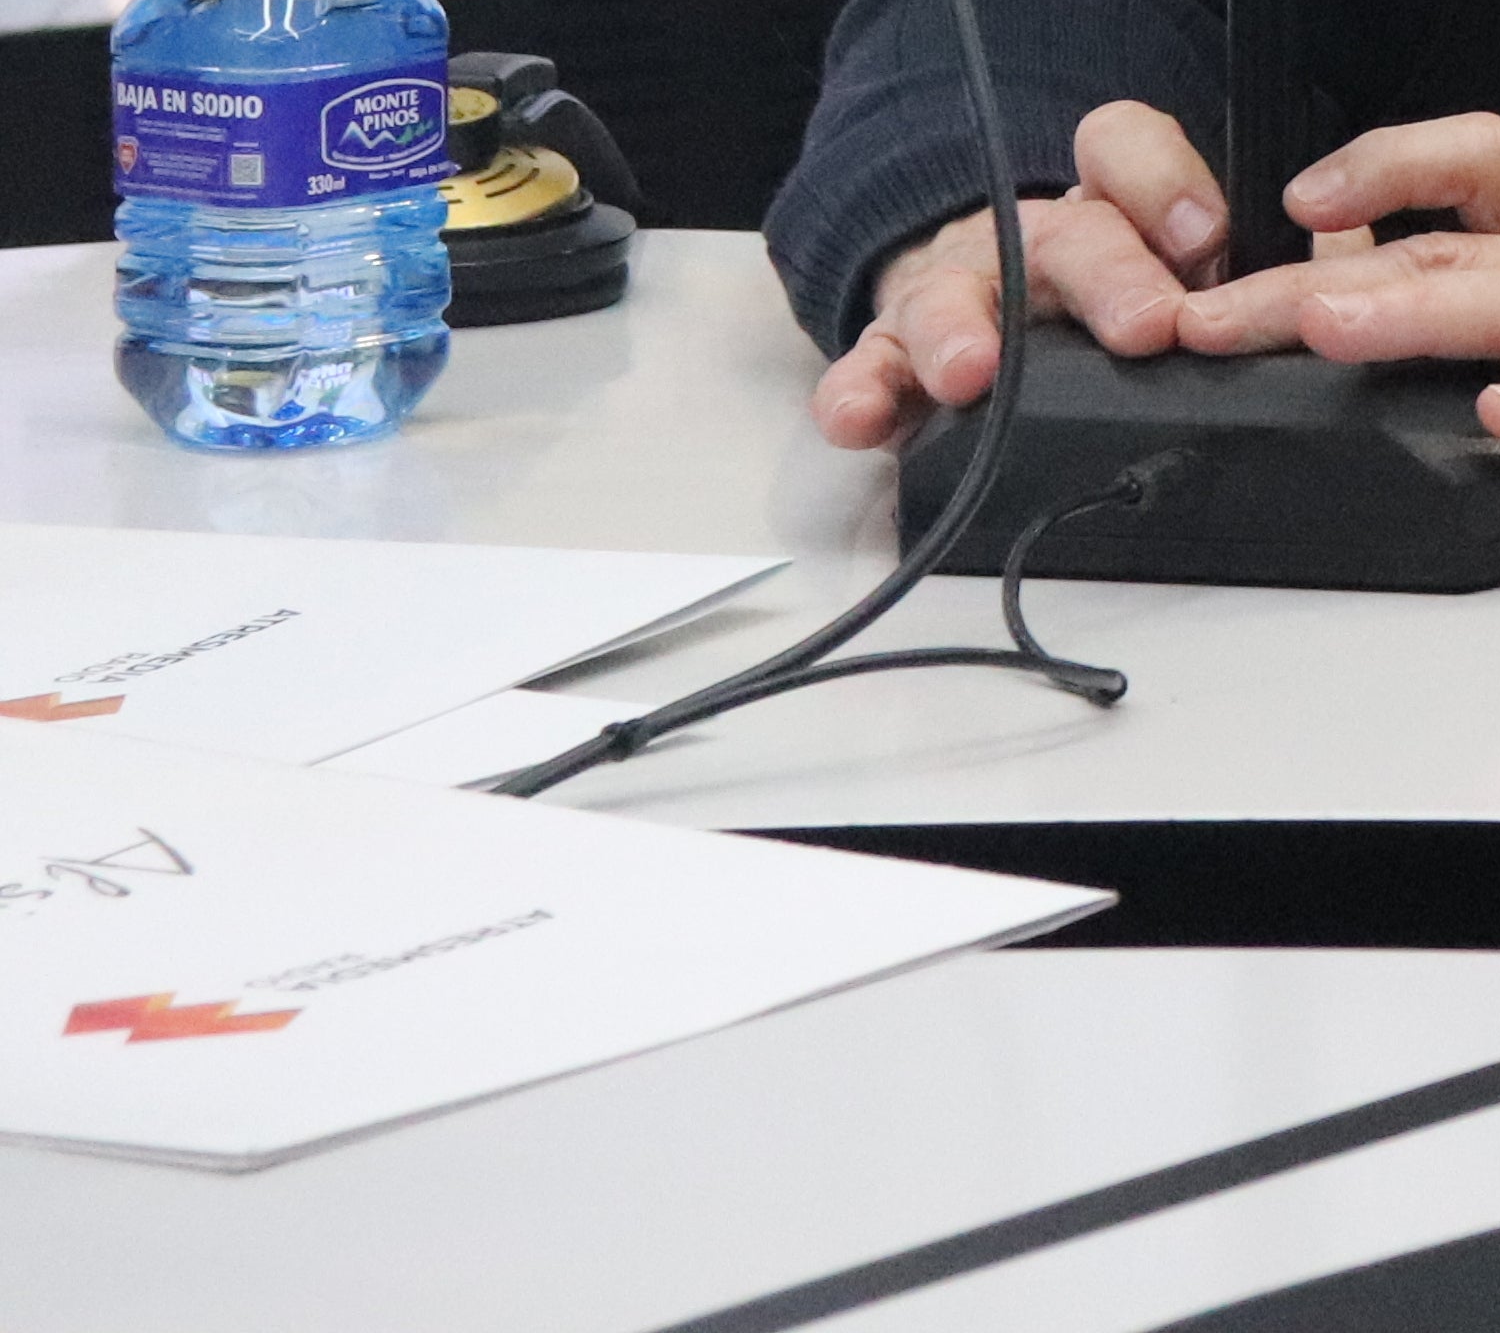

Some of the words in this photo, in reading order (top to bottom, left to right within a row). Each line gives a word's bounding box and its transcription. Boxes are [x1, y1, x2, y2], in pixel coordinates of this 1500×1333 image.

[117, 82, 158, 115] BAJA
[162, 89, 187, 113] EN
[191, 92, 264, 119] SODIO
[354, 89, 420, 115] MONTE
[363, 107, 420, 132] PINOS
[87, 608, 302, 684] ATRESMEDIA
